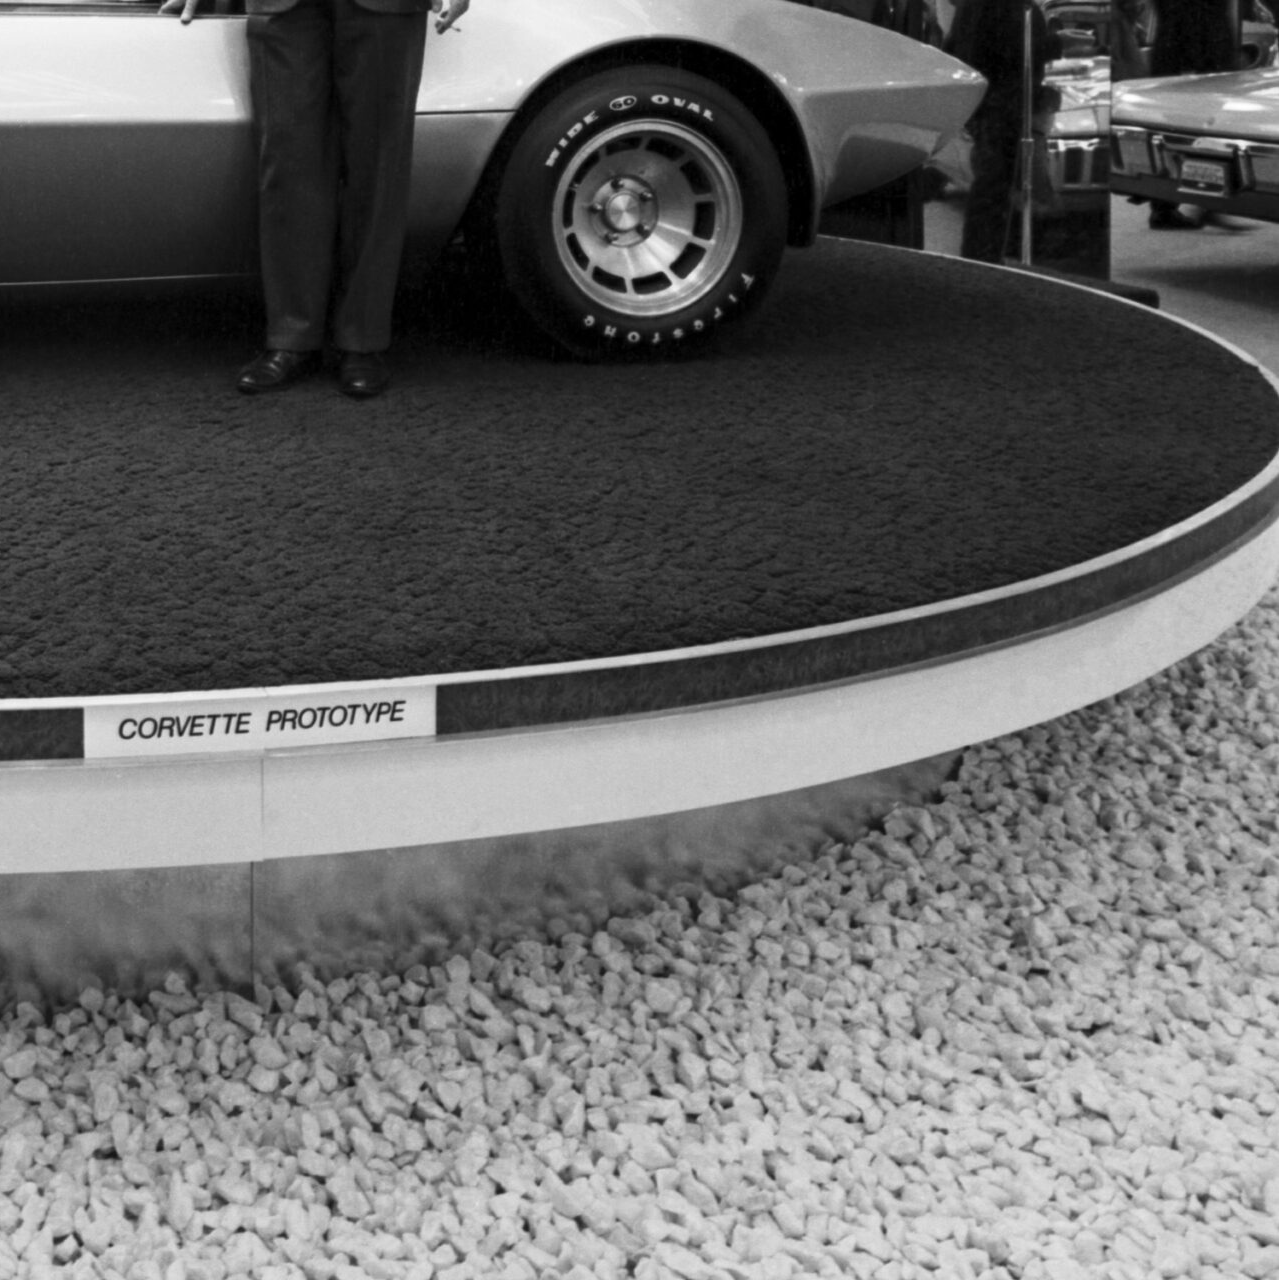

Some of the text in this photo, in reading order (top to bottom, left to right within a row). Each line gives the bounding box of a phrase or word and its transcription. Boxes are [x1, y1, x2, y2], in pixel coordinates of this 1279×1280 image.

[545, 110, 600, 168] WIDE
[650, 94, 714, 122] OVAL
[118, 700, 407, 740] CORVETTE PROTOTYPE
